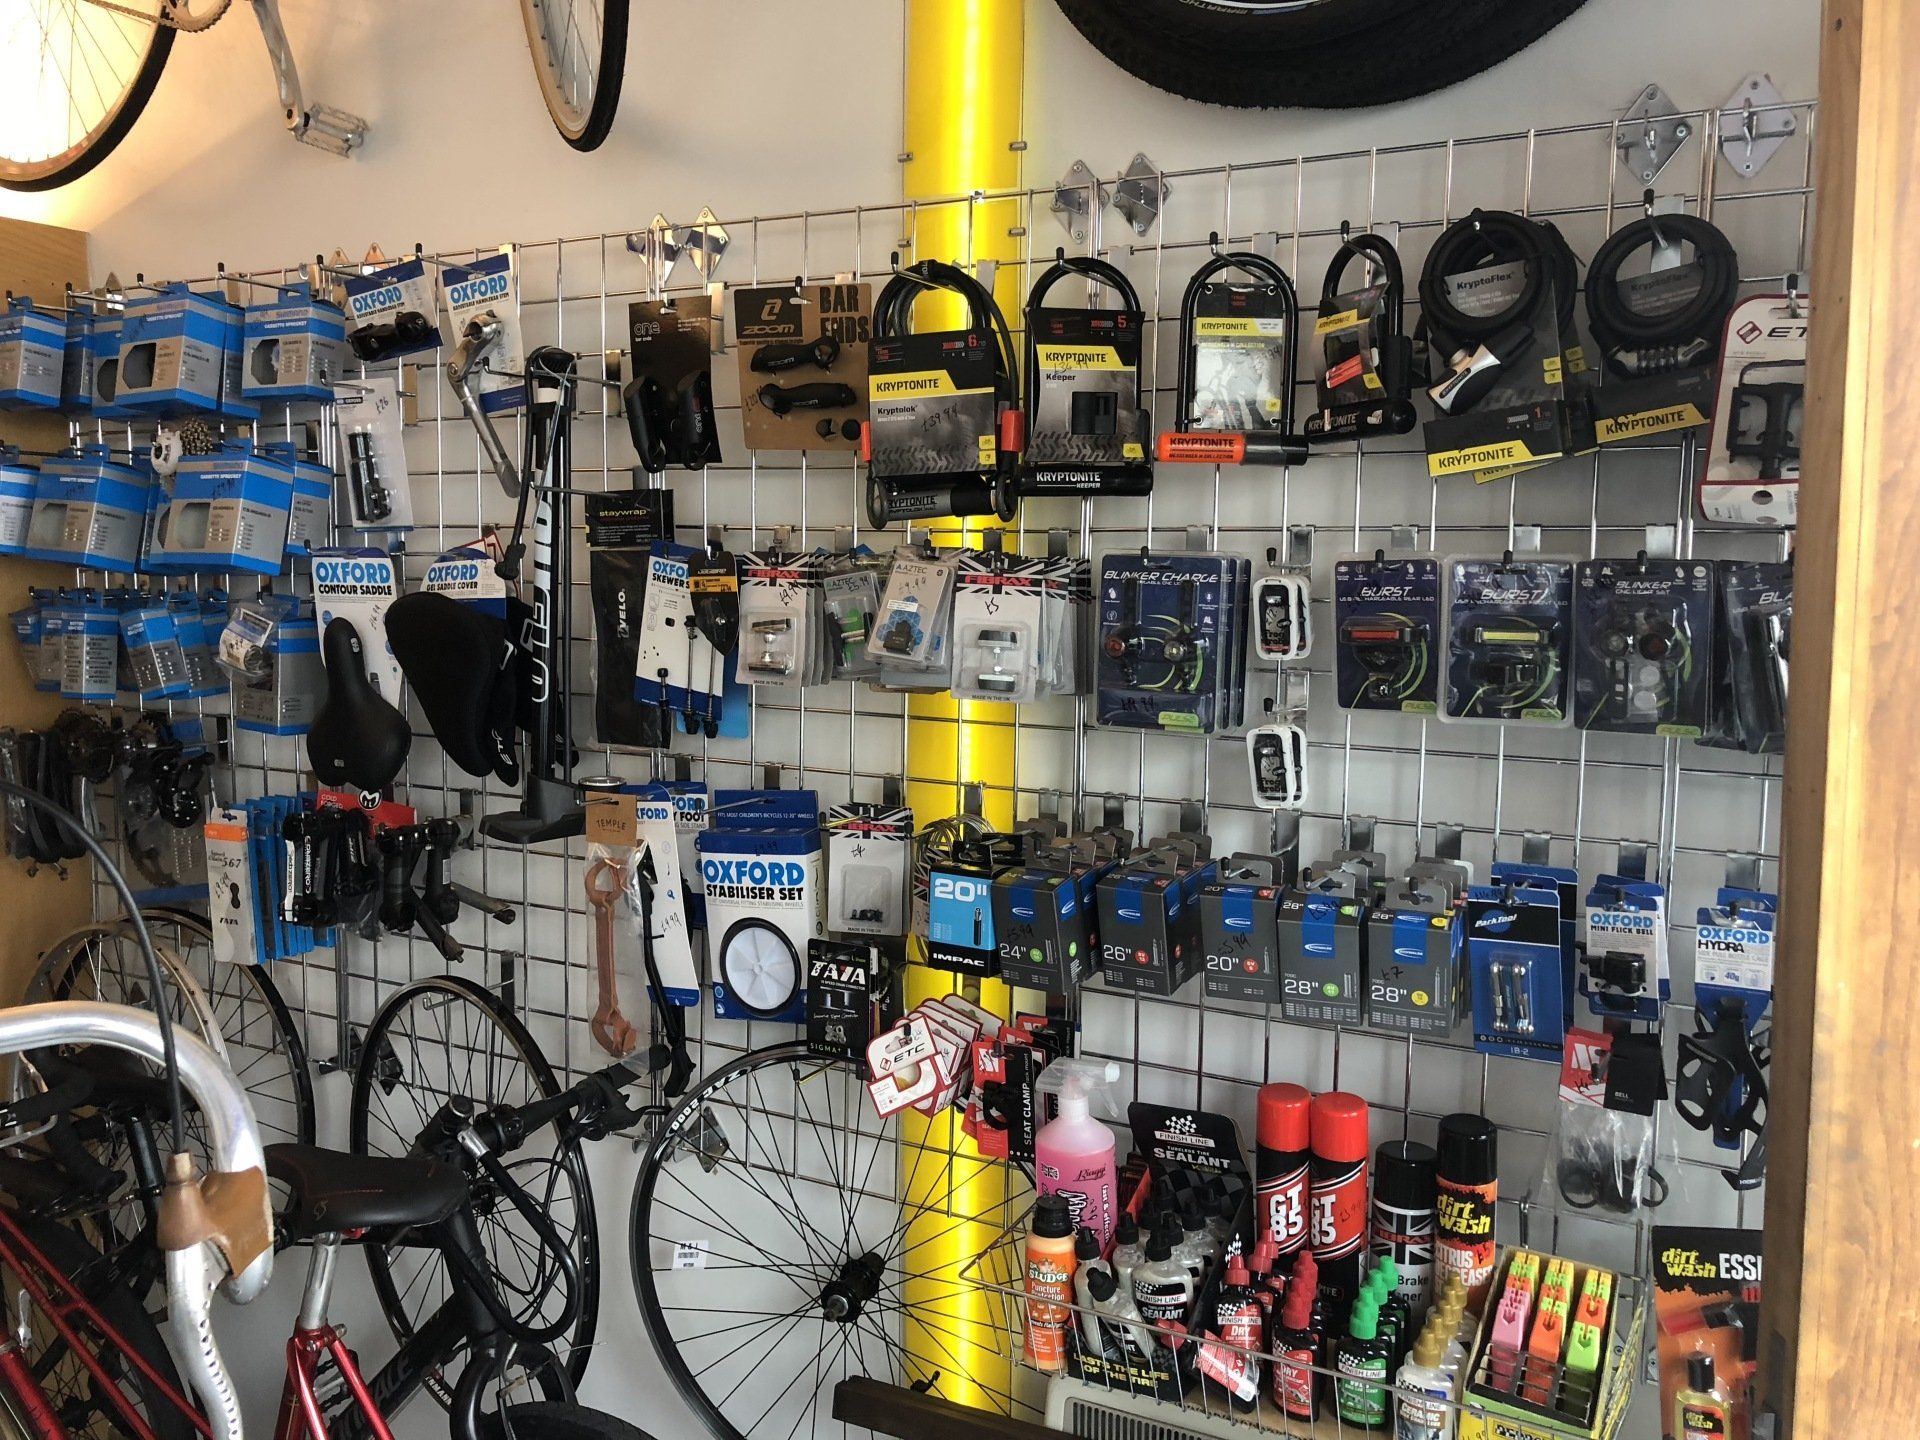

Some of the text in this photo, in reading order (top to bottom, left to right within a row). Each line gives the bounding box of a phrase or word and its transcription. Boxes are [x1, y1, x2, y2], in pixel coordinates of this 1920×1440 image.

[450, 274, 508, 304] OXFORD
[1456, 273, 1512, 291] KryptoFlex
[352, 285, 403, 313] OXFORD
[819, 286, 859, 314] BAR
[633, 321, 661, 336] one
[820, 316, 869, 343] ENDS
[1201, 321, 1248, 331] KRYPTONITE
[1767, 326, 1808, 338] ET
[1045, 351, 1107, 364] KRYPTONITE
[876, 378, 940, 393] KRYPTONITE
[1046, 373, 1076, 383] Keeper
[877, 405, 916, 415] Kryptolok
[1308, 413, 1357, 431] KRYTONITE
[1605, 410, 1685, 435] KRYPTONITE
[1169, 437, 1235, 448] KRYPTONITE
[1438, 446, 1515, 469] KRYPTONITE
[1036, 471, 1101, 482] KRYPTONITE
[887, 495, 937, 508] RYPTONITE
[599, 508, 647, 517] staywrap
[315, 561, 391, 584] OXFORD
[427, 564, 479, 581] OXFORD
[652, 560, 689, 580] OXFO
[747, 569, 800, 579] FIBRAX
[903, 564, 927, 575] AZTEC
[1104, 570, 1219, 583] BLINKER CHARGE
[436, 582, 456, 591] SADDLE
[457, 581, 478, 590] COVER
[652, 572, 690, 589] SKEWERS
[832, 577, 853, 587] AZTEC
[964, 574, 1032, 587] FIBRAX
[1615, 581, 1672, 590] BLINKER
[318, 584, 392, 596] CONTOUR SADDLE
[1361, 586, 1412, 597] BURST
[1481, 588, 1542, 600] BURST
[1759, 591, 1793, 604] BLA
[618, 590, 627, 629] VELO
[671, 796, 706, 811] FORD
[636, 807, 668, 819] XFORD
[680, 812, 705, 822] FOOT
[596, 818, 627, 831] TEMPLE
[222, 857, 241, 868] 567
[703, 859, 805, 886] OXFORD
[706, 884, 804, 901] STABILISER SET
[934, 878, 987, 902] 20"
[1283, 901, 1304, 910] 28"
[1372, 912, 1394, 920] 28"
[1590, 912, 1654, 928] OXFORD
[1611, 926, 1633, 934] FLICK
[1698, 926, 1770, 945] OXFORD
[1000, 943, 1026, 959] 24"
[1103, 944, 1132, 961] 26"
[1697, 939, 1745, 953] HYDRA
[932, 952, 985, 968] IMPAC
[1206, 955, 1239, 972] 20"
[1284, 979, 1319, 996] 28"
[1371, 985, 1408, 1003] 28"
[893, 1042, 926, 1063] ETC
[1022, 1082, 1031, 1118] CLAMP
[1614, 1091, 1629, 1099] BELL
[671, 1098, 700, 1131] 2000
[1023, 1120, 1032, 1146] SEAT
[1159, 1132, 1210, 1146] FINISH LINE
[1153, 1147, 1231, 1170] SEALANT
[1270, 1182, 1303, 1217] GT
[1311, 1194, 1336, 1220] GT
[1437, 1194, 1475, 1219] dirt
[1269, 1208, 1304, 1243] 85
[1311, 1215, 1336, 1246] 85
[1439, 1211, 1491, 1235] wash
[1661, 1248, 1699, 1264] dirt
[1028, 1269, 1069, 1283] SLUDGE
[1666, 1262, 1717, 1278] wash
[1031, 1281, 1061, 1293] Puncture
[1398, 1274, 1429, 1285] Brake
[1140, 1295, 1163, 1303] FINISH
[1141, 1308, 1184, 1320] SEALANT
[1231, 1325, 1251, 1336] DRY
[1073, 1352, 1170, 1381] LASTS THE LIFE
[1083, 1364, 1100, 1374] OF
